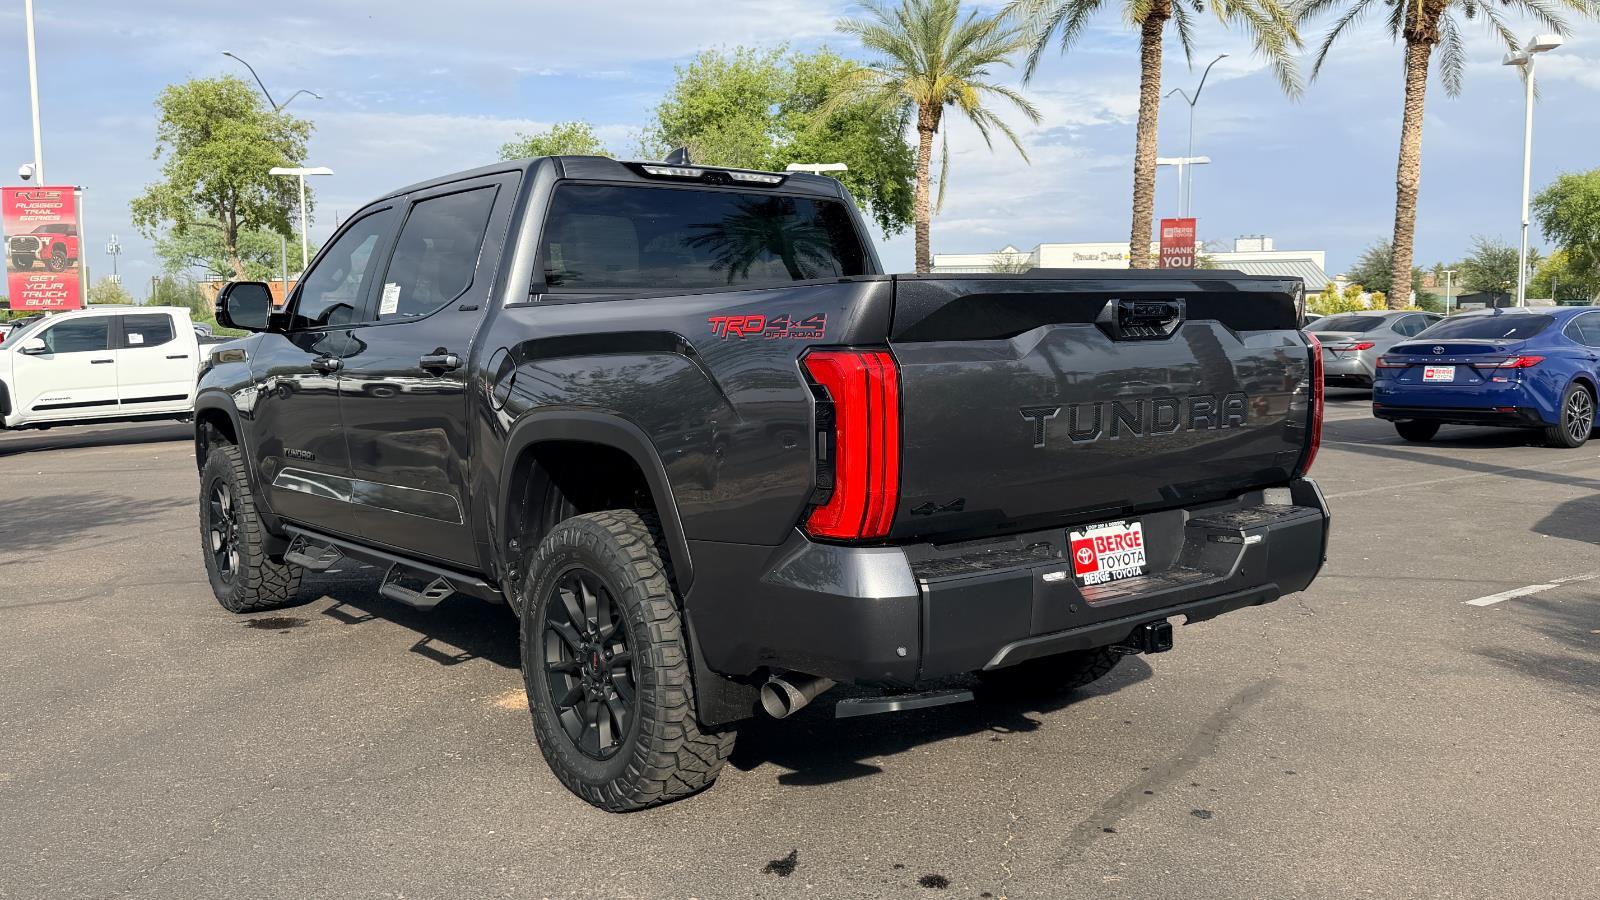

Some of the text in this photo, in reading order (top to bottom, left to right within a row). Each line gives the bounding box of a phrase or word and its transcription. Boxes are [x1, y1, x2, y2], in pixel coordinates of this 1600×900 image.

[1162, 246, 1193, 255] THANK
[1163, 256, 1192, 268] YOU
[707, 314, 766, 340] TRD
[1019, 391, 1249, 448] TUNDRA
[1095, 531, 1142, 554] BERGE
[1099, 551, 1145, 570] TOYOTA
[1083, 566, 1142, 585] BERGE TOYOTA
